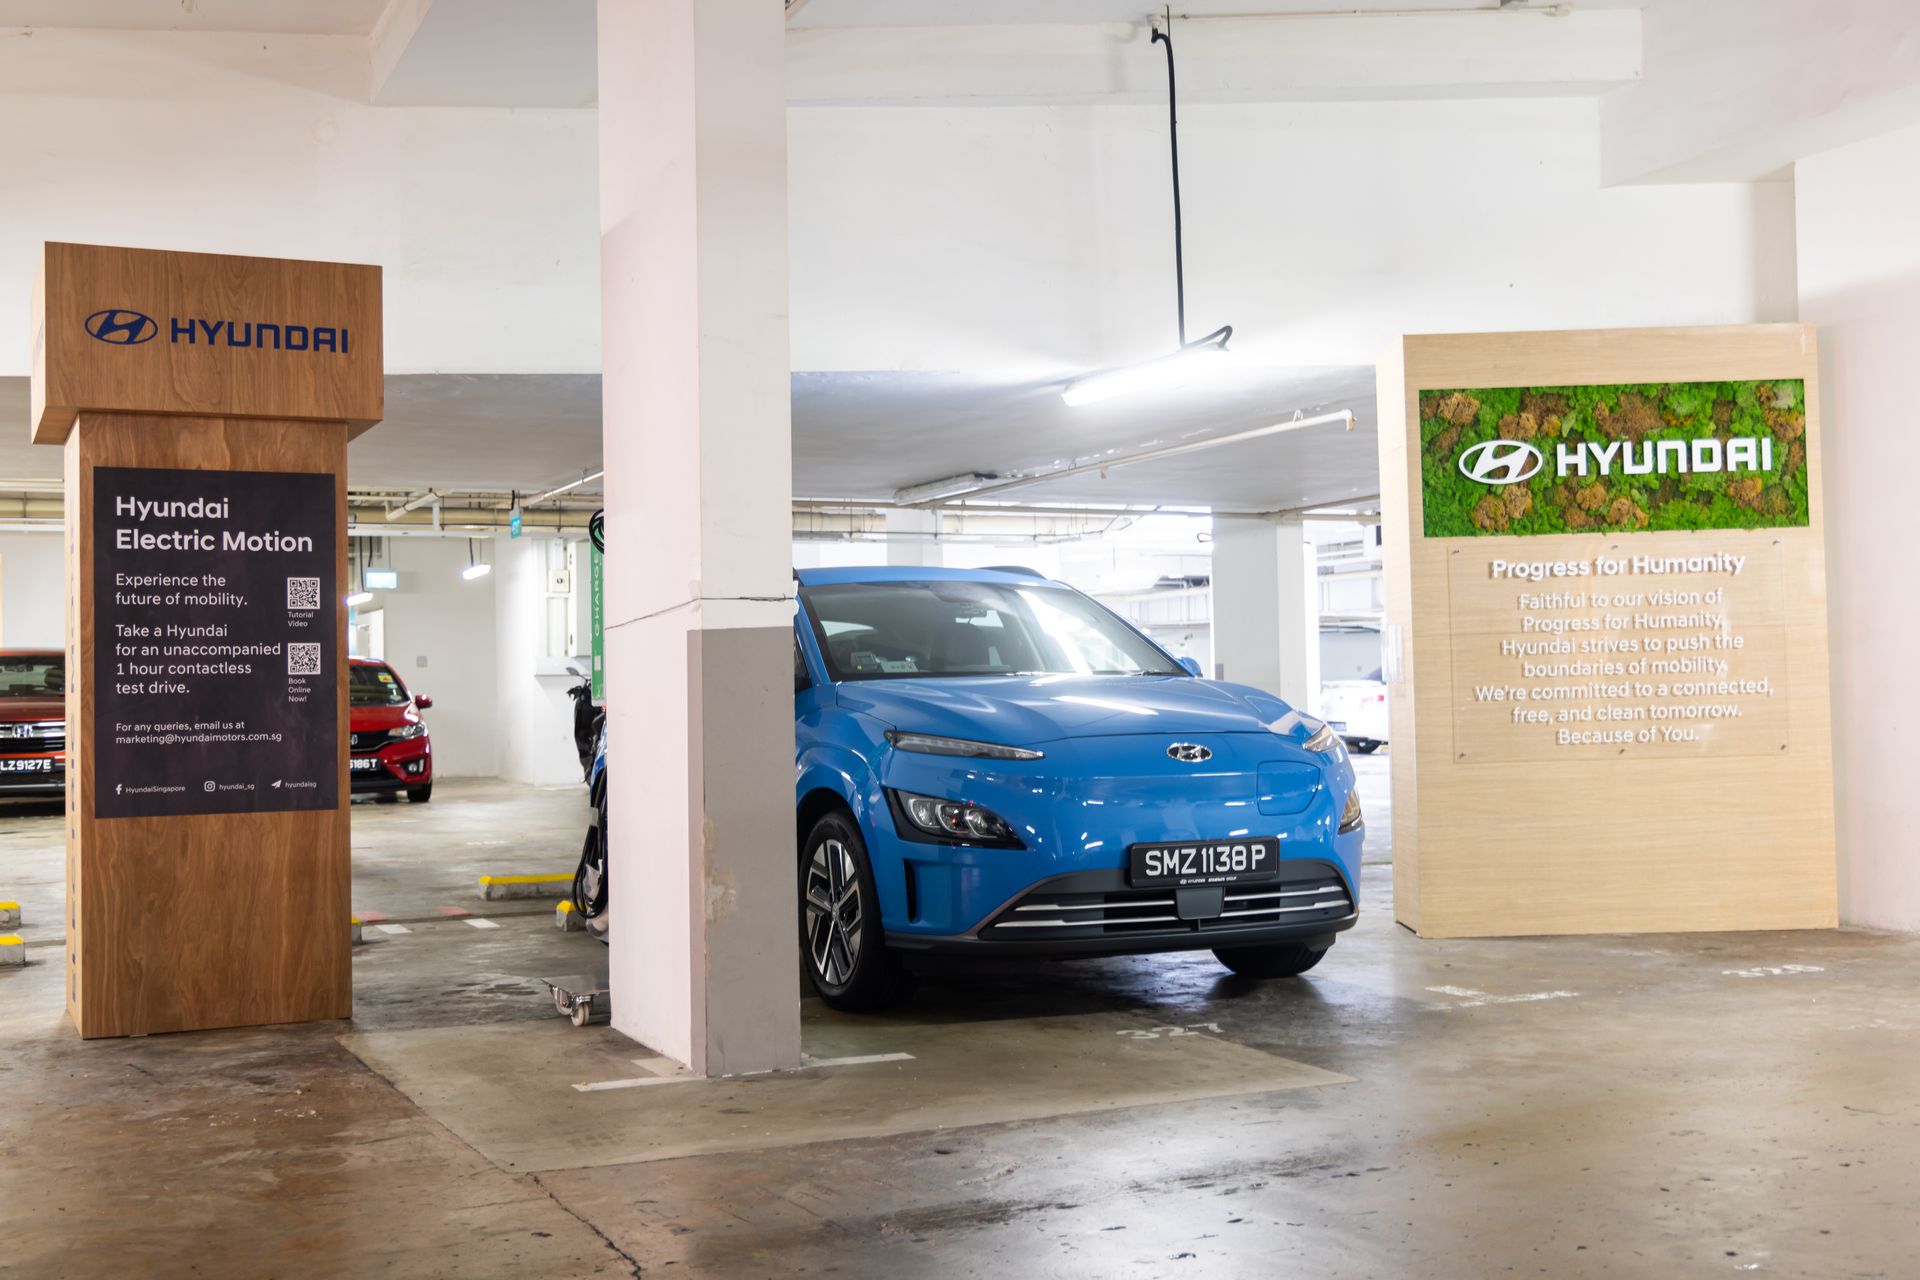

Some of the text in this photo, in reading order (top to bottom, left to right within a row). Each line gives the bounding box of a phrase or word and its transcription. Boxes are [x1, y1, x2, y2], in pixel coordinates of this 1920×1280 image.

[171, 318, 348, 353] HYUNDAI
[1557, 437, 1772, 477] HYUNDAI
[116, 496, 229, 521] Hyundai
[116, 529, 313, 552] Electric Motion
[1492, 551, 1745, 581] Progress for Humanity
[116, 573, 226, 589] Experience the
[116, 592, 248, 609] future of mobility.
[1519, 587, 1723, 611] Faithful to our vision of
[116, 623, 228, 640] Take a Hyundai
[1523, 616, 1599, 636] Progress
[1603, 614, 1629, 630] for
[116, 642, 281, 658] for an unaccompanied
[1502, 631, 1744, 658] Hyundai strives to push the
[116, 661, 252, 675] 1 hour contactless
[1524, 660, 1624, 678] boundaries
[1628, 659, 1648, 676] of
[116, 680, 190, 694] test drive.
[288, 686, 311, 694] Online
[1475, 676, 1774, 701] We're committed to a connected,
[1513, 703, 1742, 725] free, and clean tomorrow.
[116, 720, 245, 734] For any queries, email us at
[1558, 725, 1699, 745] Because of You.
[116, 733, 282, 745] marketing@hyundaimotors.com.sg
[125, 785, 186, 794] HyundaiSingapore
